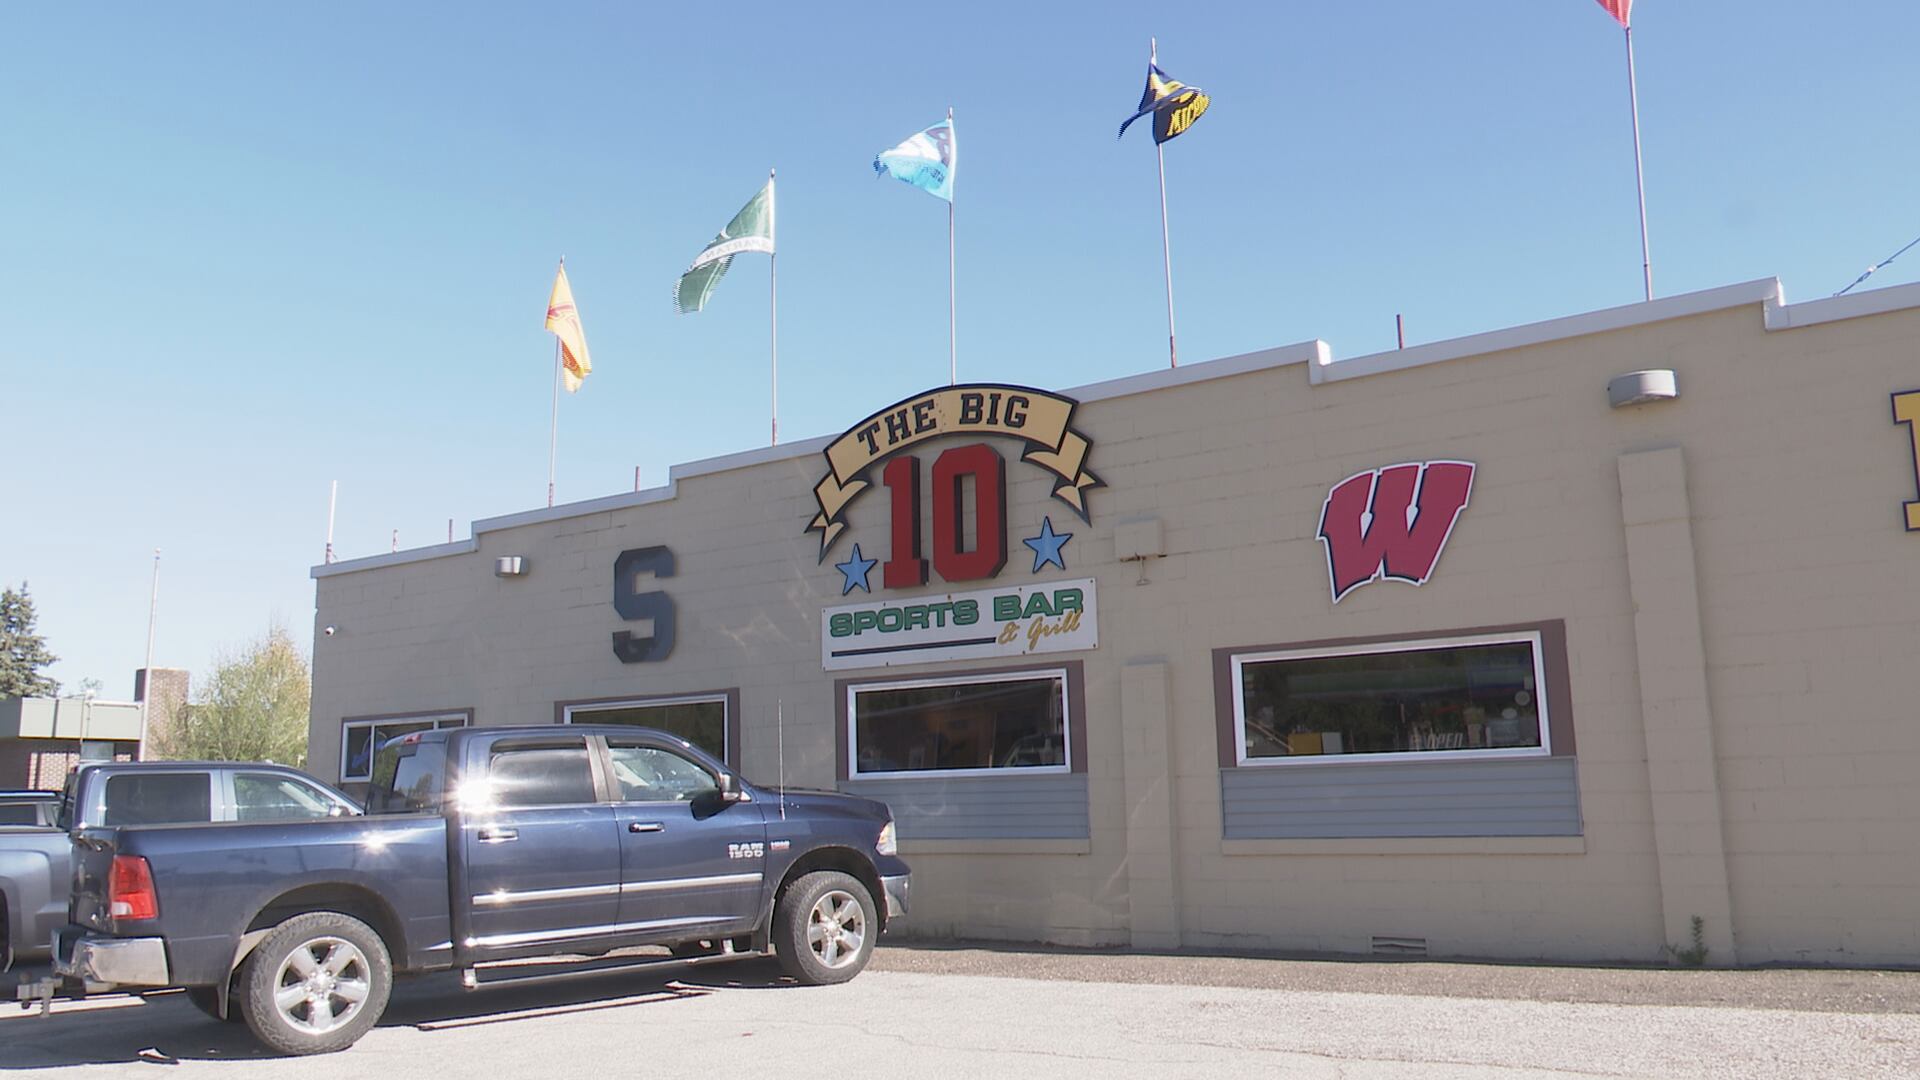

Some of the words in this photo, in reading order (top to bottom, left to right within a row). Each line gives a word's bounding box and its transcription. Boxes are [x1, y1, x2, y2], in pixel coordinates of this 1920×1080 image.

[857, 399, 937, 456] THE
[959, 393, 1030, 429] BIG
[883, 443, 1008, 589] 10
[1316, 460, 1476, 604] W
[612, 545, 676, 664] S
[830, 599, 979, 638] SPORTS
[993, 588, 1084, 622] BAR
[1027, 608, 1082, 651] Grill
[728, 842, 764, 851] RAM
[728, 850, 764, 859] 1500
